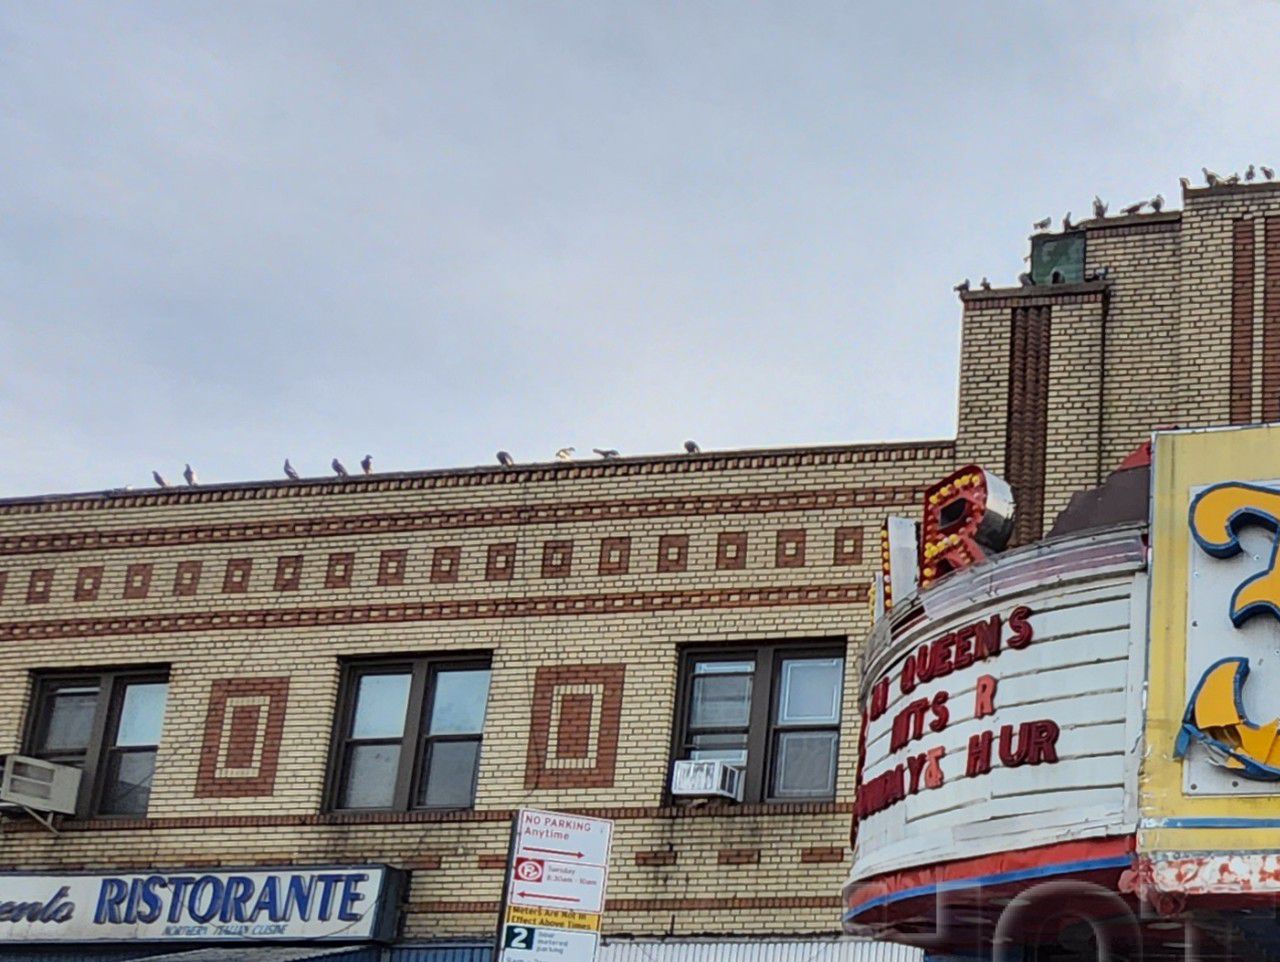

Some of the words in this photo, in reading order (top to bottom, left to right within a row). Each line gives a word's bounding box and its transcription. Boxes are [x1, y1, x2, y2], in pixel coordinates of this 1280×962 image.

[900, 606, 1033, 694] QUEENS
[974, 674, 998, 719] R
[966, 719, 1060, 778] HUR
[524, 827, 570, 840] Anytime
[525, 815, 540, 824] NO
[544, 818, 591, 832] PARKING
[93, 874, 370, 924] RISTORANTE
[252, 924, 288, 935] CUISINE
[511, 915, 537, 924] Effect
[539, 918, 564, 926] Above
[568, 921, 591, 929] Times
[510, 927, 528, 948] 2
